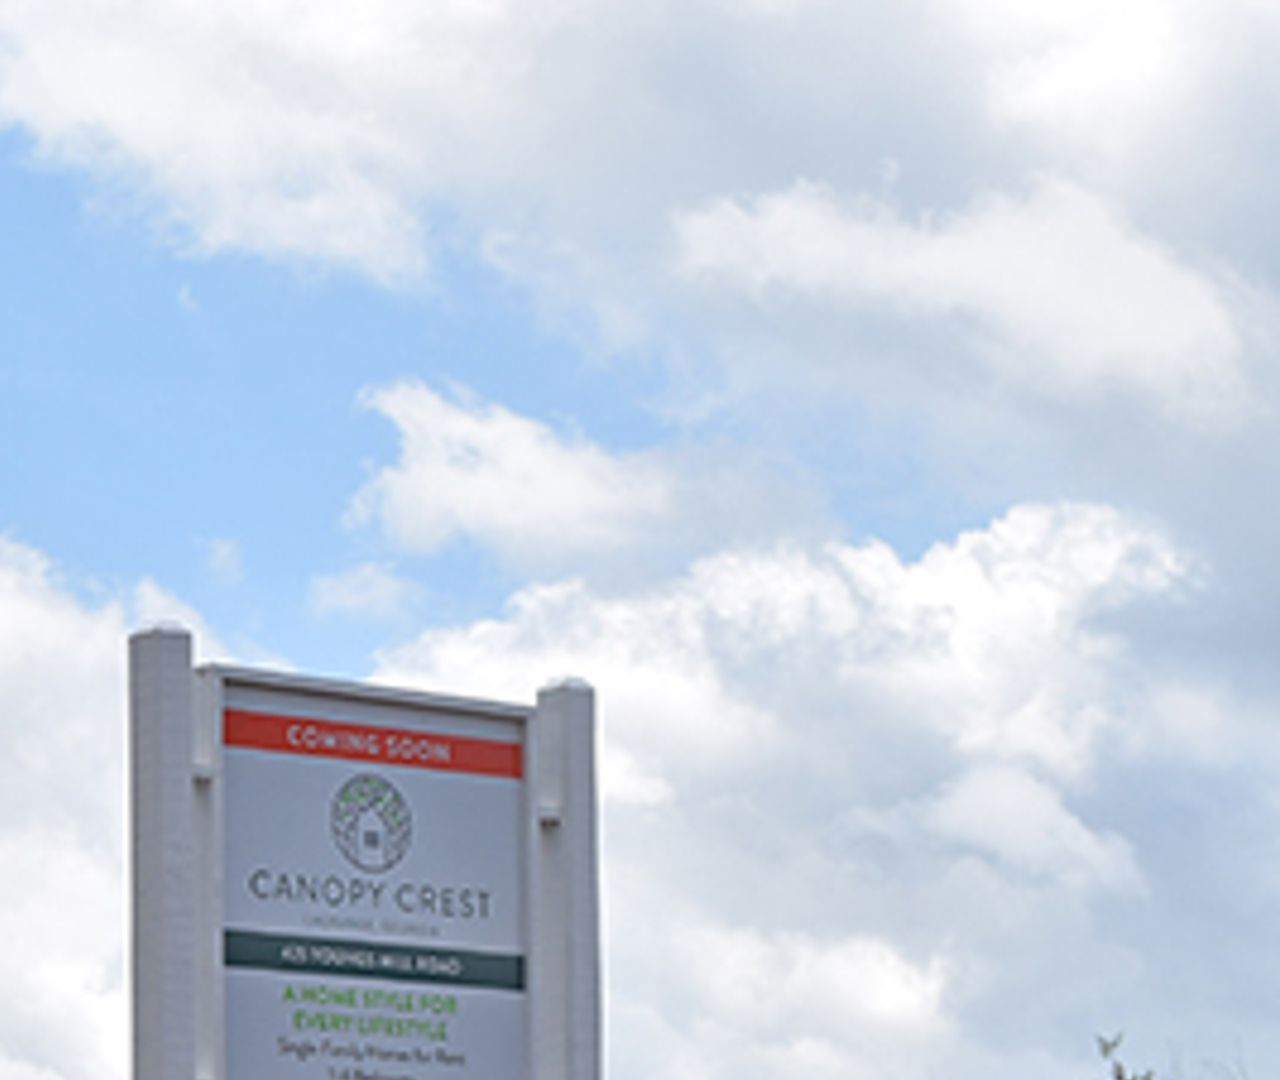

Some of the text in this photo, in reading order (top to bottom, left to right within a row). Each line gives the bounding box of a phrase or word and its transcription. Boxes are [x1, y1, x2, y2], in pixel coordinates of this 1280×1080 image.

[286, 723, 452, 763] COMING SOON
[248, 868, 490, 919] CANOPY CREST
[283, 985, 457, 1016] A HOME STYLE FOR
[293, 1009, 447, 1042] EVERY LIFESTYLE
[277, 1036, 316, 1062] Single
[320, 1038, 364, 1063] Family
[435, 1047, 466, 1067] Rent
